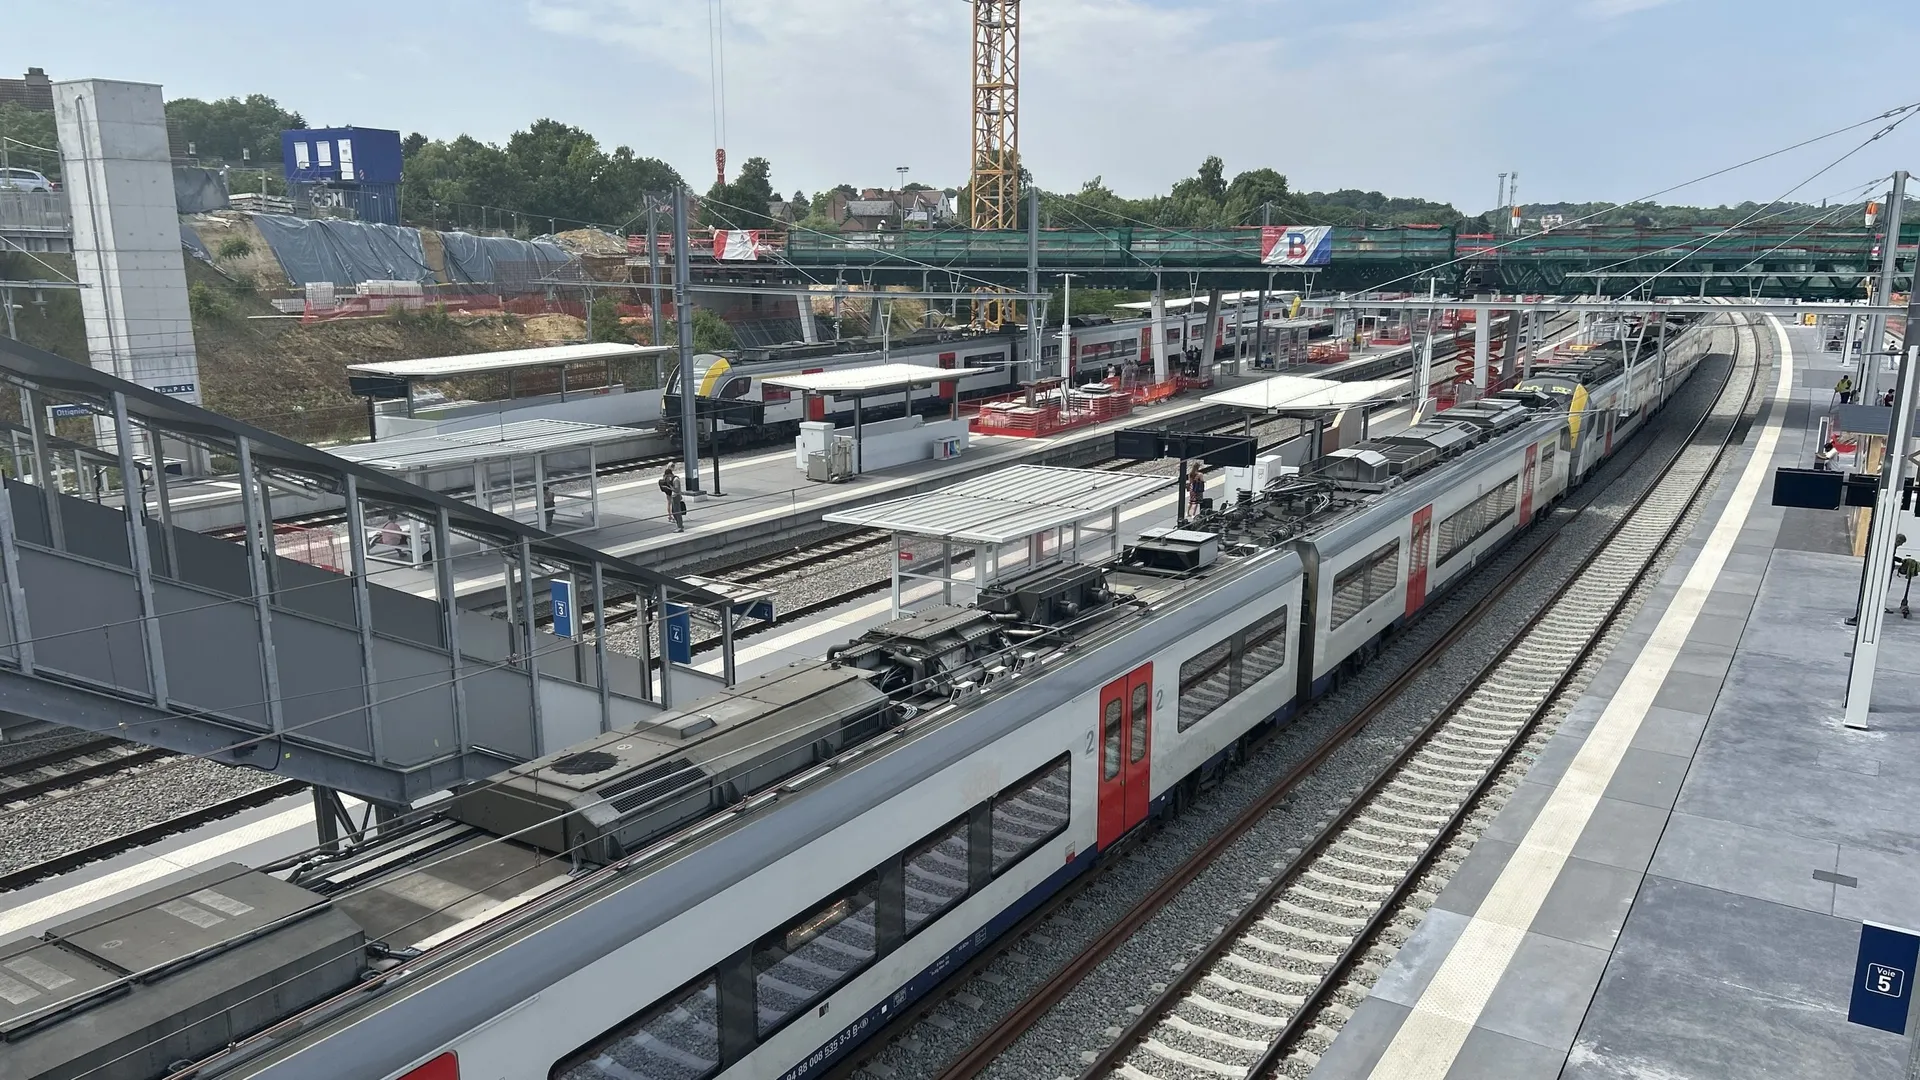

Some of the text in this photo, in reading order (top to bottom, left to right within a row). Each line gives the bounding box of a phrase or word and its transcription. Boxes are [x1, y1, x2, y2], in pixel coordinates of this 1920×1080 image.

[1287, 232, 1307, 258] B
[558, 606, 564, 615] 3
[673, 631, 680, 640] 4
[1156, 688, 1164, 711] 2
[1085, 730, 1094, 755] 2
[1876, 965, 1896, 978] Voie
[1877, 975, 1892, 992] 5
[798, 1061, 808, 1076] 88
[809, 1050, 823, 1068] 008
[824, 1039, 838, 1057] 535
[839, 1029, 851, 1045] 3-3
